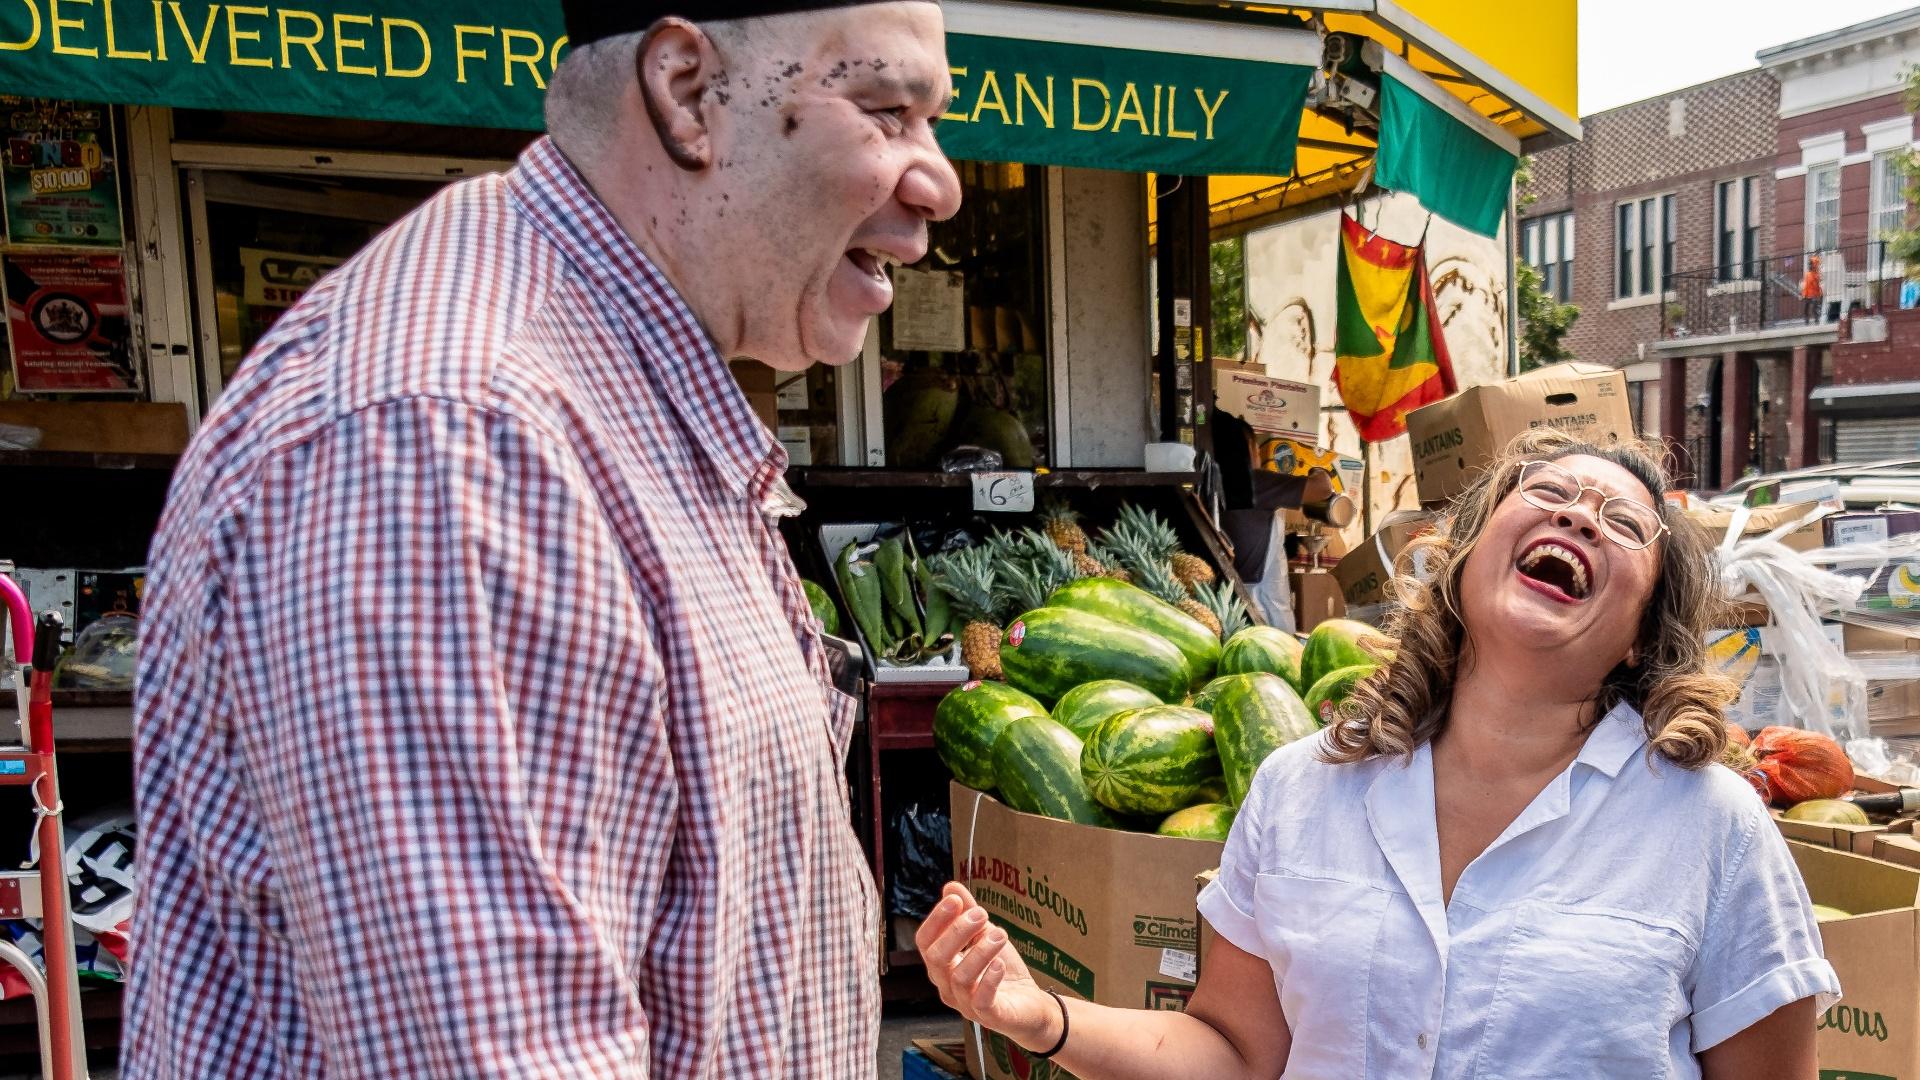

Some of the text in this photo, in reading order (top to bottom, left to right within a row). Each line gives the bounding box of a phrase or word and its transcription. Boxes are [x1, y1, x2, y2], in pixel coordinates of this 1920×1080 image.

[0, 0, 432, 78] DELIVERED
[1072, 78, 1230, 140] DAILY
[8, 137, 103, 169] BINGO
[33, 169, 88, 190] $10,000
[1530, 413, 1598, 429] PLANTAINS
[1414, 427, 1464, 460] PLANTAINS
[975, 886, 1042, 928] watermelons
[1052, 951, 1080, 985] Treat
